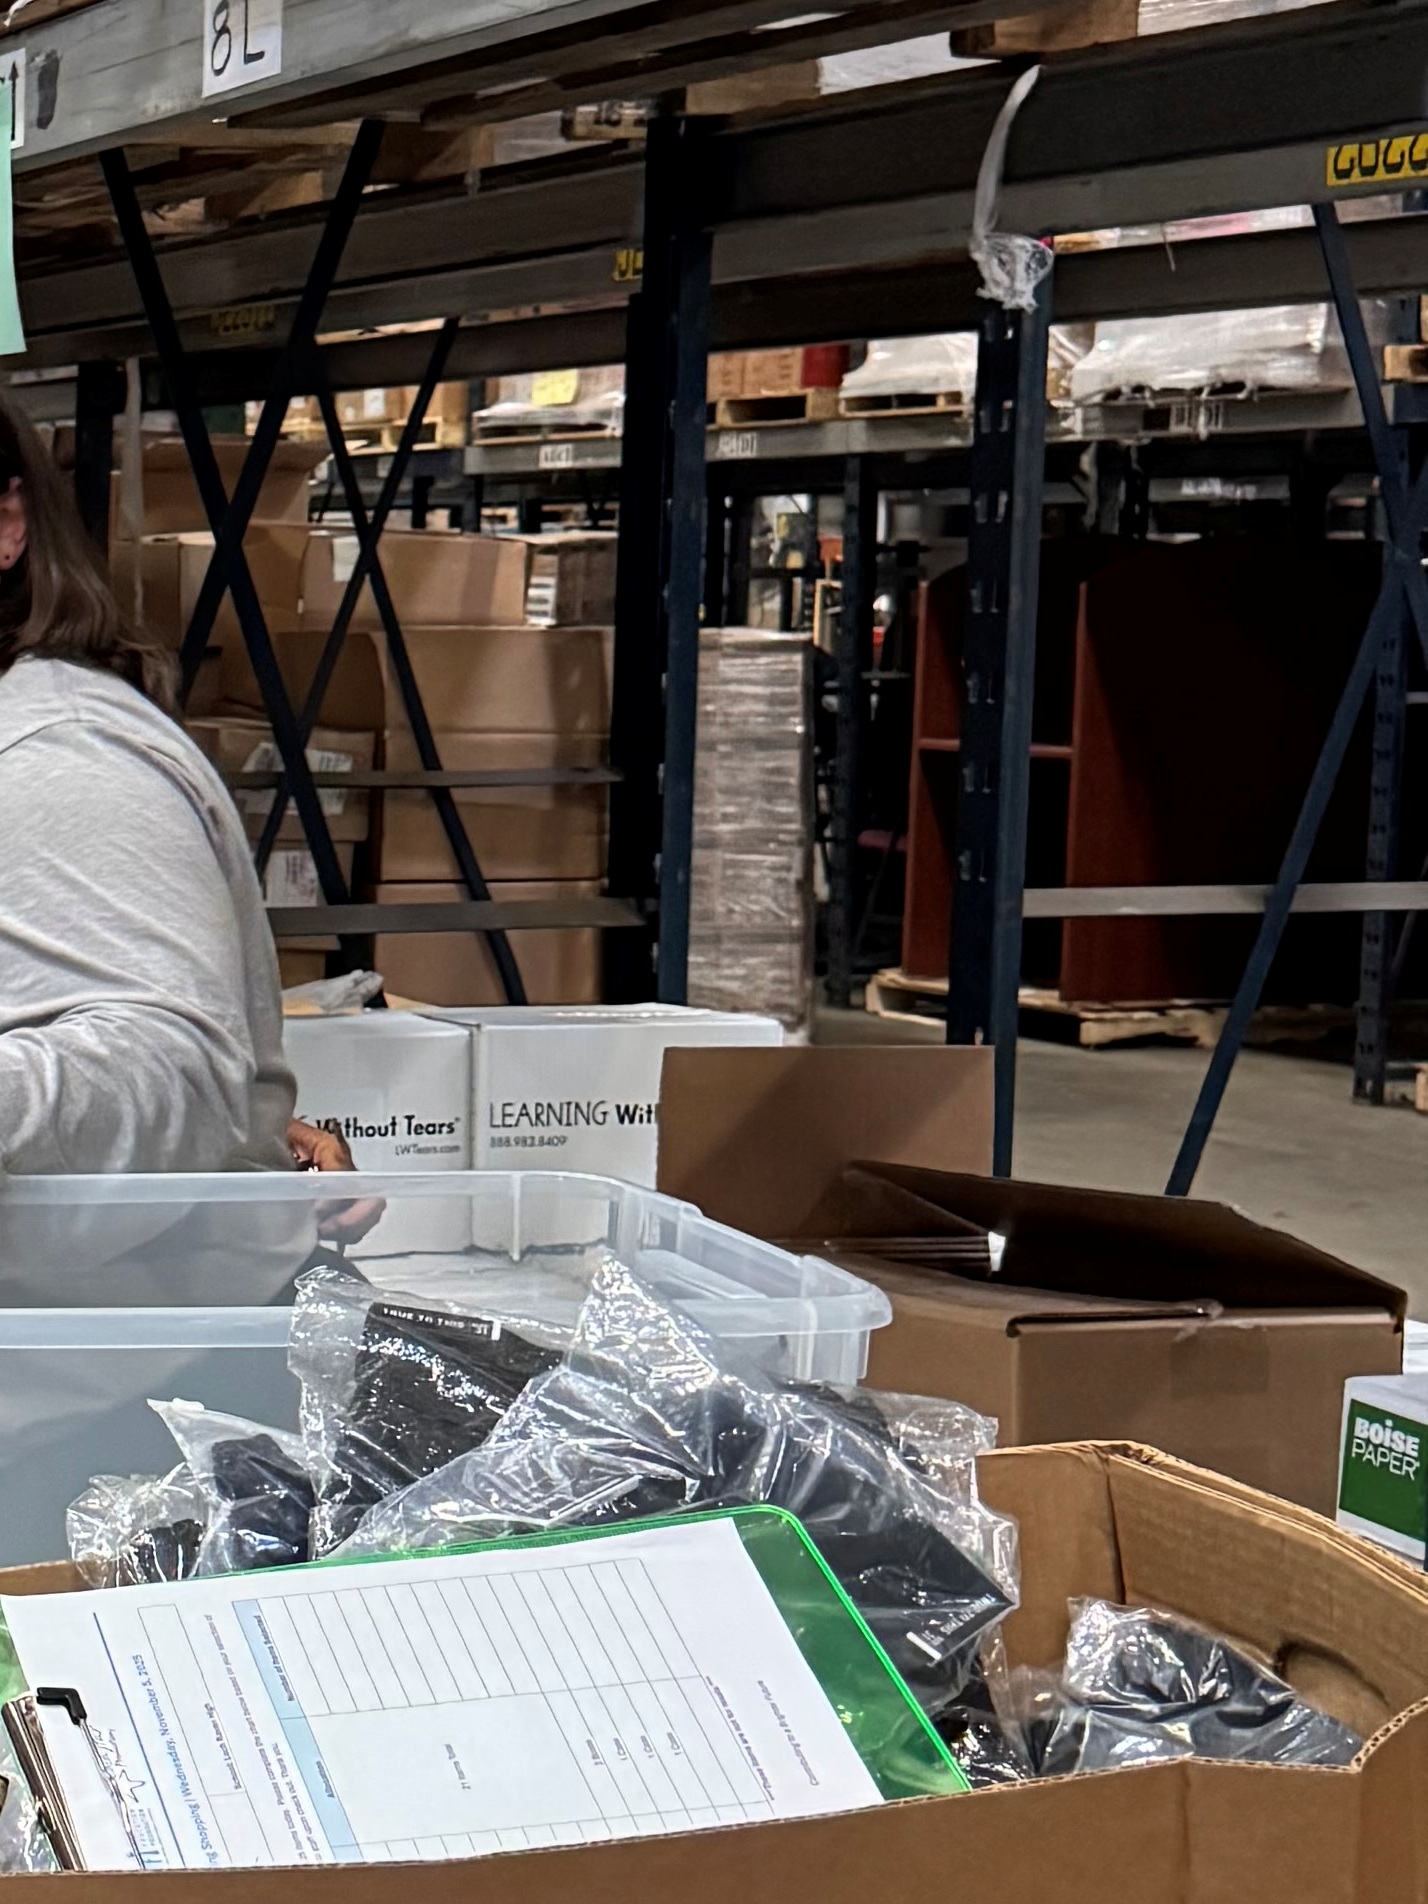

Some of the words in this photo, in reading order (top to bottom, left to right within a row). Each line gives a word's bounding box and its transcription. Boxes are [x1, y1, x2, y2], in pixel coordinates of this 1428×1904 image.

[489, 1100, 608, 1129] LEARNING
[1351, 1438, 1416, 1481] PAPER
[251, 1614, 273, 1644] Selected
[272, 1665, 284, 1673] of
[275, 1674, 296, 1701] Number
[140, 1687, 174, 1736] November
[202, 1702, 219, 1718] High
[252, 1735, 264, 1746] the
[158, 1738, 198, 1796] Wednesday,
[267, 1781, 287, 1805] Please
[183, 1803, 217, 1849] Shopping
